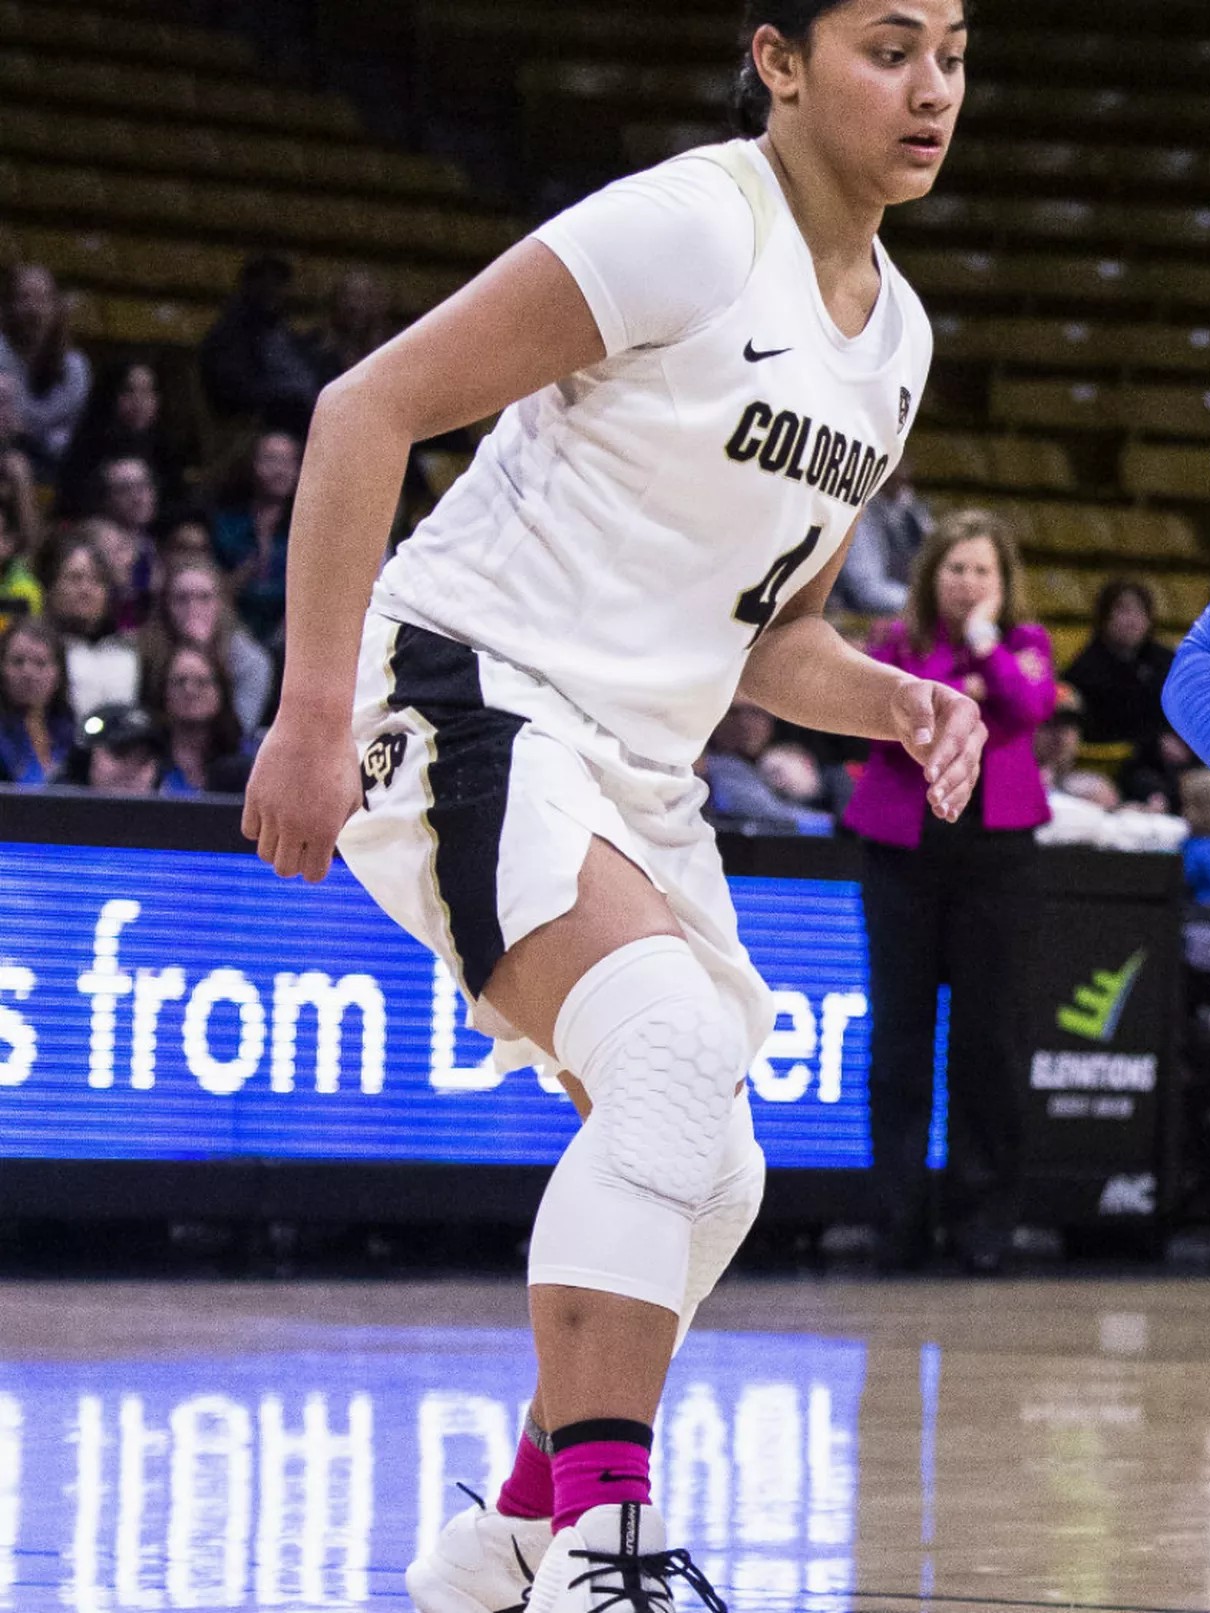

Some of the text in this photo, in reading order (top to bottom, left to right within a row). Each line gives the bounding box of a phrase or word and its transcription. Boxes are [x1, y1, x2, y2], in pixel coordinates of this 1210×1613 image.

[725, 401, 890, 506] COLORADO
[731, 524, 822, 651] 4
[76, 899, 388, 1095] from
